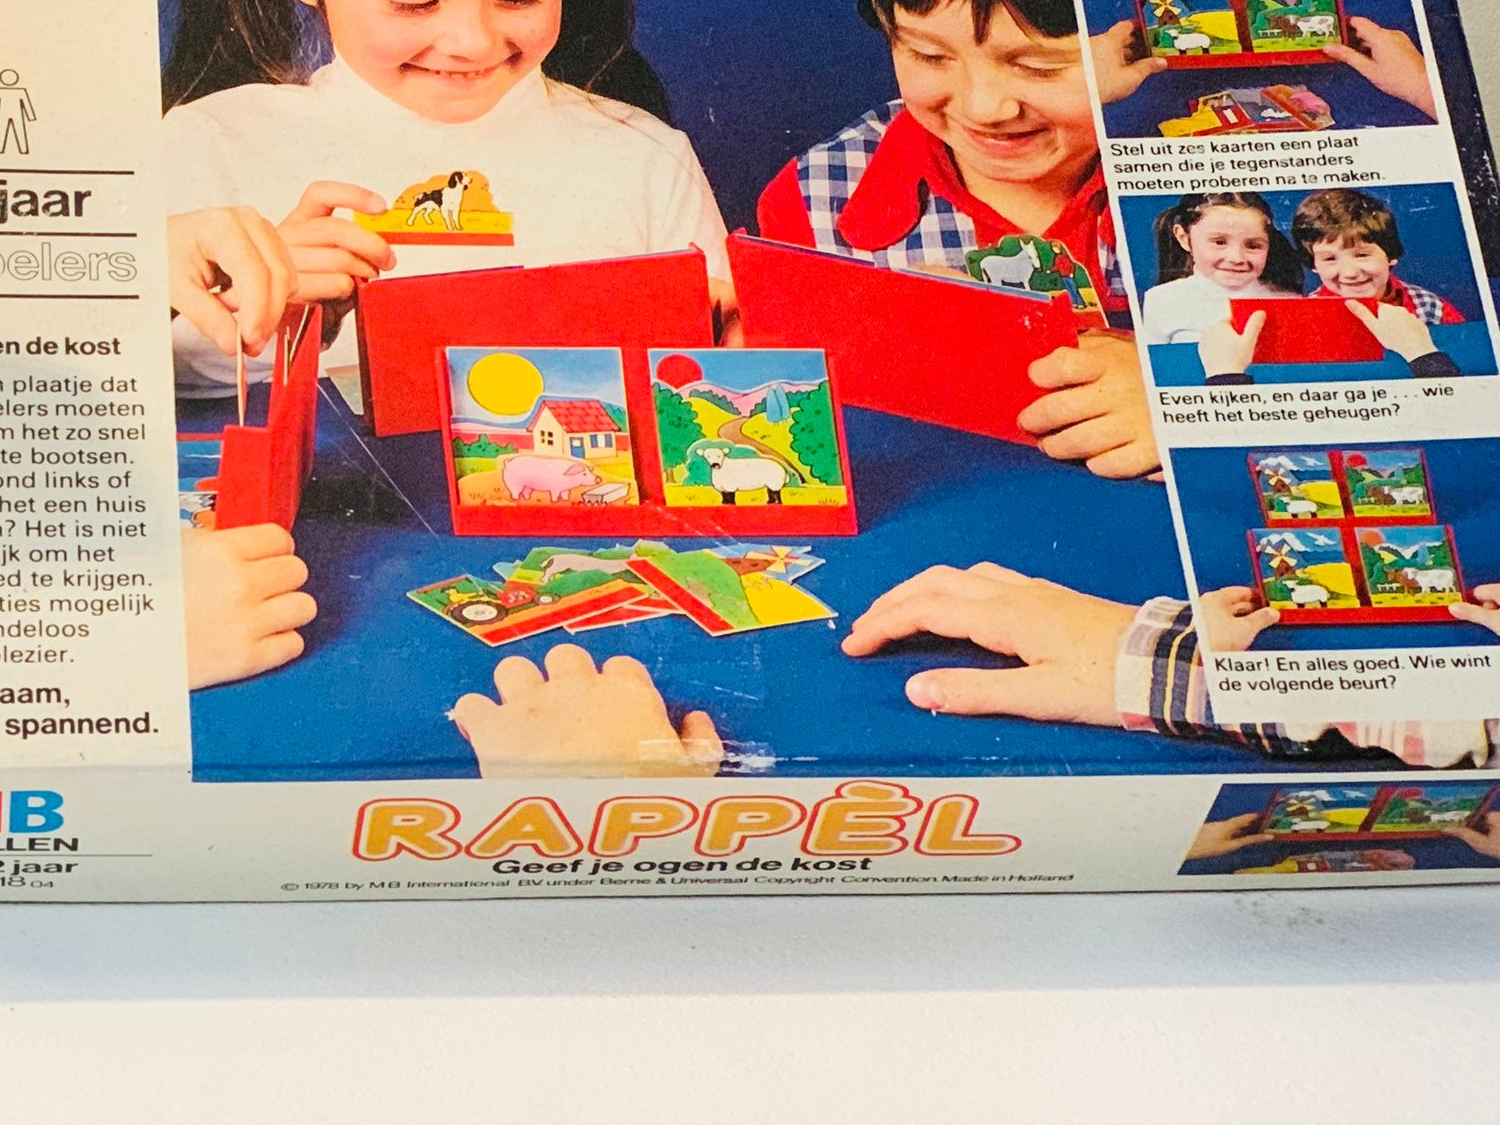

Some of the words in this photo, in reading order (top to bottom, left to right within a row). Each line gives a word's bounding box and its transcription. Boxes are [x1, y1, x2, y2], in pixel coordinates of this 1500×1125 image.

[1111, 144, 1144, 156] Stel
[1151, 145, 1172, 155] uit
[1179, 145, 1204, 154] zes
[1210, 141, 1275, 153] kaarten
[1281, 141, 1311, 150] een
[1317, 137, 1358, 151] plaat
[1114, 163, 1172, 173] samen
[1179, 160, 1204, 171] die
[1211, 160, 1224, 173] je
[1230, 154, 1353, 171] tegenstanders
[1118, 179, 1184, 190] moeten
[1190, 176, 1270, 191] proberen
[1276, 176, 1296, 184] na
[1301, 174, 1317, 184] te
[1324, 170, 1386, 182] maken.
[26, 337, 58, 355] de
[65, 337, 121, 355] kost
[13, 376, 92, 396] plaatje
[101, 376, 137, 392] dat
[1160, 392, 1204, 405] Even
[1210, 391, 1267, 407] kijken,
[1273, 393, 1293, 402] en
[1300, 389, 1338, 401] daar
[1345, 390, 1366, 403] ga
[1373, 389, 1386, 402] je
[1422, 387, 1453, 396] wie
[56, 402, 144, 416] moeten
[1163, 410, 1209, 423] heeft
[1215, 410, 1243, 422] het
[1249, 408, 1297, 421] beste
[1303, 403, 1400, 422] geheugen?
[23, 423, 59, 440] het
[66, 428, 91, 440] zo
[98, 424, 145, 440] snel
[1, 449, 21, 464] te
[32, 448, 133, 464] bootsen.
[46, 472, 99, 488] links
[108, 471, 131, 488] of
[0, 496, 35, 513] het
[45, 500, 87, 512] een
[97, 496, 146, 512] huis
[26, 520, 65, 537] Het
[76, 520, 93, 537] is
[103, 520, 146, 537] niet
[29, 550, 67, 562] om
[78, 545, 114, 562] het
[31, 572, 53, 587] te
[64, 570, 151, 591] krijgen.
[50, 594, 154, 616] mogelijk
[1215, 658, 1269, 671] Klaar!
[1276, 657, 1300, 671] En
[1307, 658, 1348, 671] alles
[1354, 656, 1405, 673] goed.
[1409, 656, 1445, 668] Wie
[1451, 656, 1490, 667] wint
[1219, 678, 1241, 691] de
[1248, 677, 1333, 694] volgende
[1339, 675, 1396, 689] beurt?
[6, 712, 158, 739] spannend.
[352, 780, 1021, 860] RAPPÈL
[11, 860, 78, 875] jaar
[493, 859, 584, 874] Geef
[589, 859, 624, 875] je
[634, 861, 727, 874] ogen
[736, 858, 782, 871] de
[791, 858, 872, 870] kost
[305, 882, 339, 890] 1978
[345, 882, 363, 891] by
[407, 879, 510, 889] International
[547, 878, 595, 887] under
[600, 877, 651, 886] Berne
[656, 877, 666, 885] &
[671, 876, 748, 885] Universal
[754, 875, 835, 885] Copyright
[942, 875, 988, 883] Made
[1009, 874, 1074, 882] Holland
